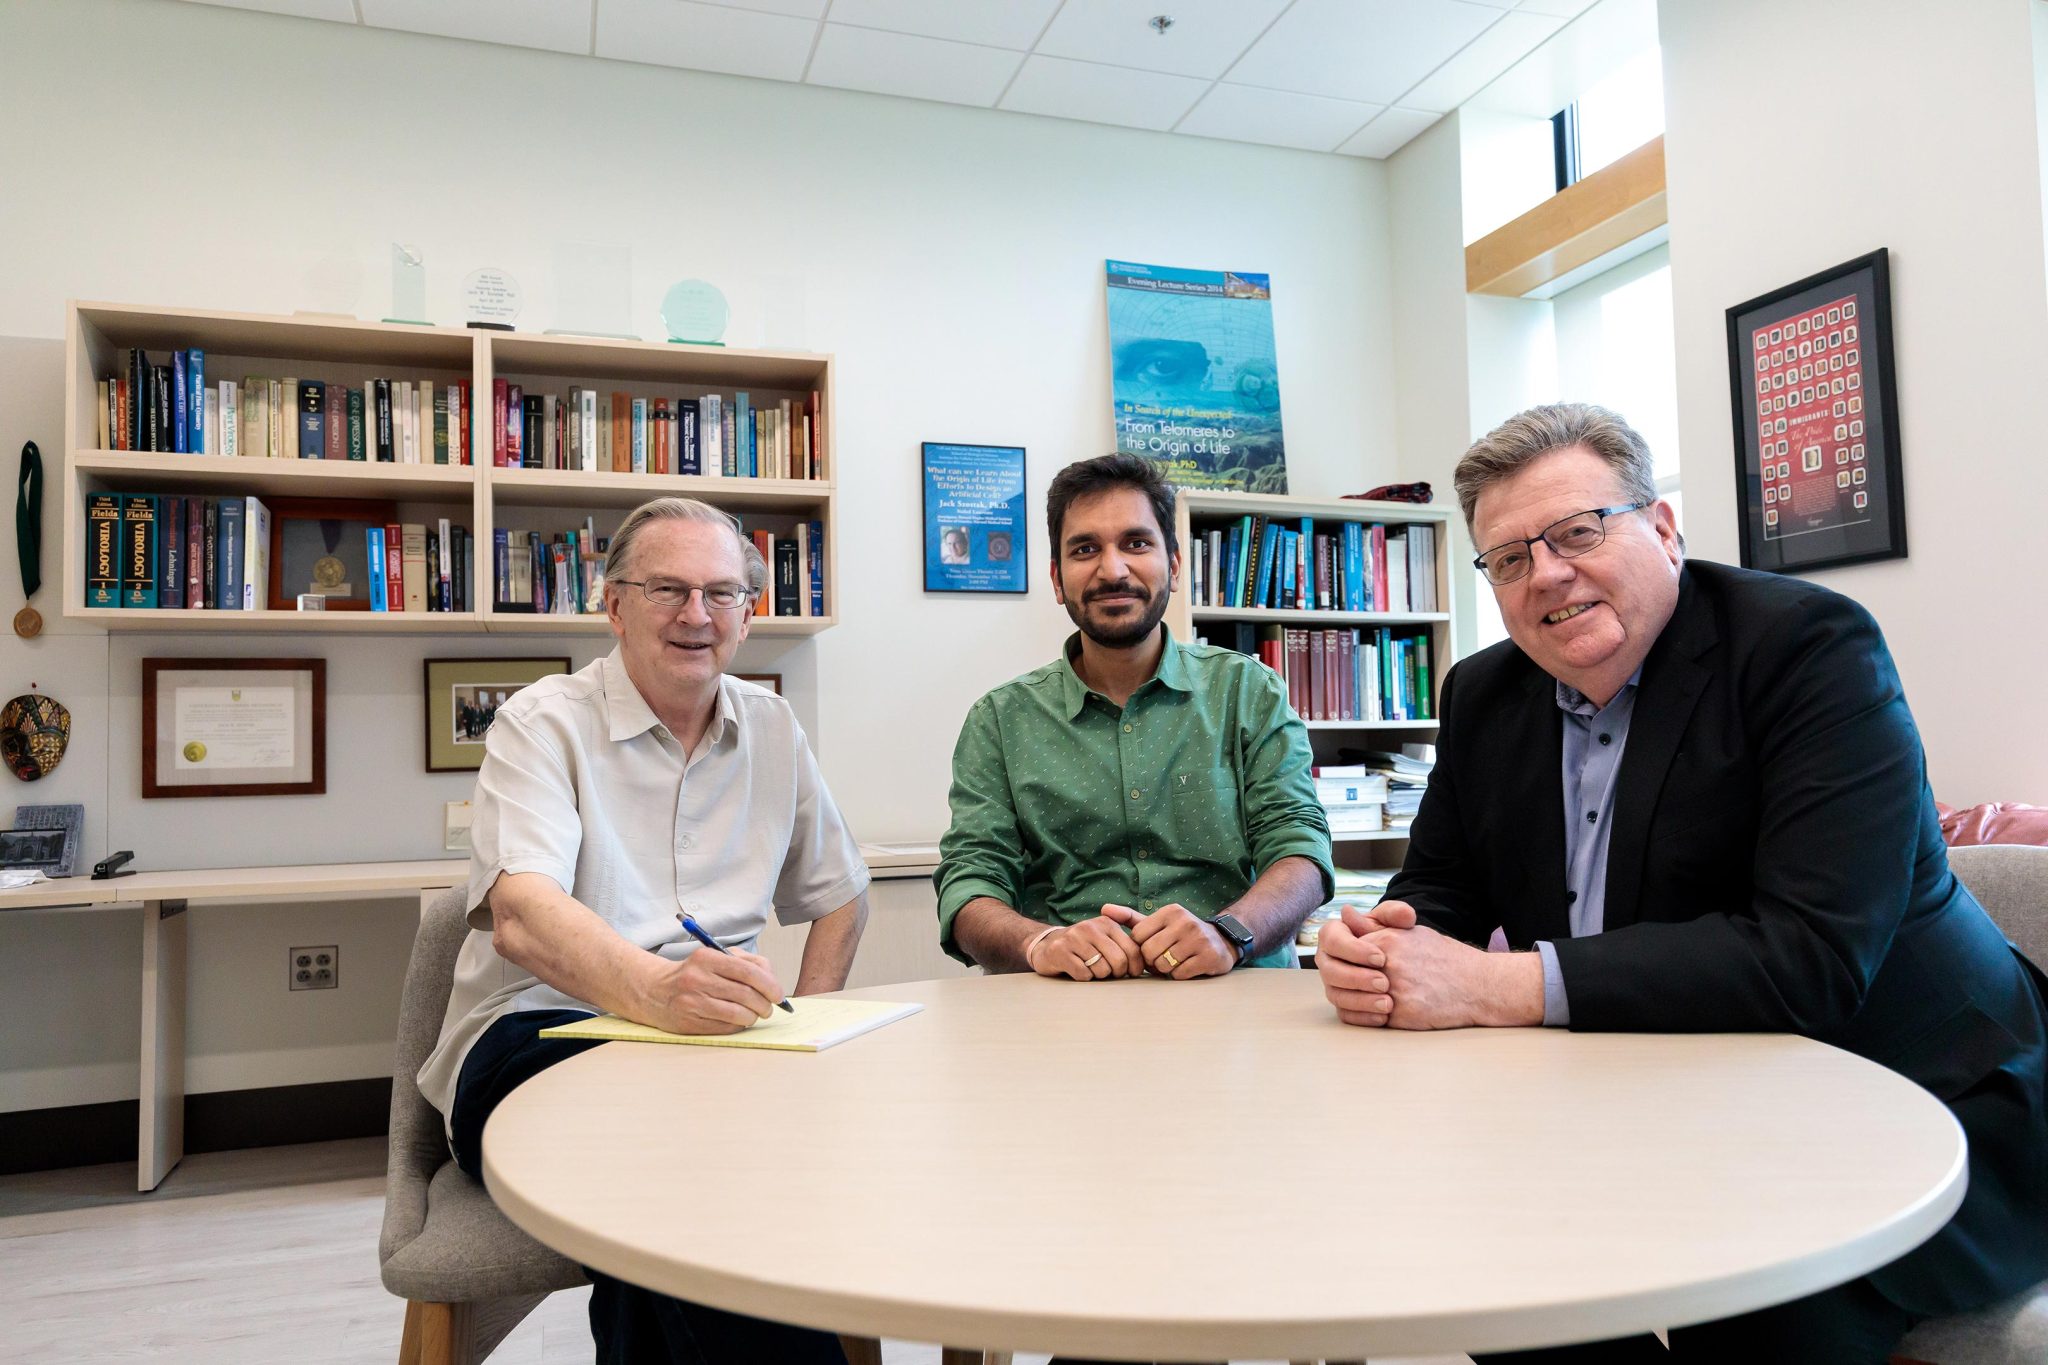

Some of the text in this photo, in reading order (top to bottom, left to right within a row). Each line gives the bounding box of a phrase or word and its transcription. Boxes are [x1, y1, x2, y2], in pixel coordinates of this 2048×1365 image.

[1127, 277, 1223, 293] Evening Lecture Series 2014
[332, 400, 340, 415] GENE
[351, 395, 361, 415] GENE
[1162, 406, 1172, 417] of
[194, 407, 202, 430] Cytometry
[225, 407, 236, 456] Plant Virology
[1125, 418, 1235, 438] From Telomeres to
[1126, 434, 1231, 456] the Origin of Life
[928, 466, 946, 474] What
[1000, 470, 1022, 478] About
[1180, 460, 1197, 468] PhD
[937, 482, 964, 490] Efforts
[975, 484, 1000, 492] Design
[947, 476, 969, 484] Origin
[92, 509, 118, 517] Fields
[127, 511, 152, 519] Fields
[99, 521, 110, 577] VIROLOGY
[134, 523, 145, 578] VIROLOGY
[166, 549, 177, 588] Lehninger
